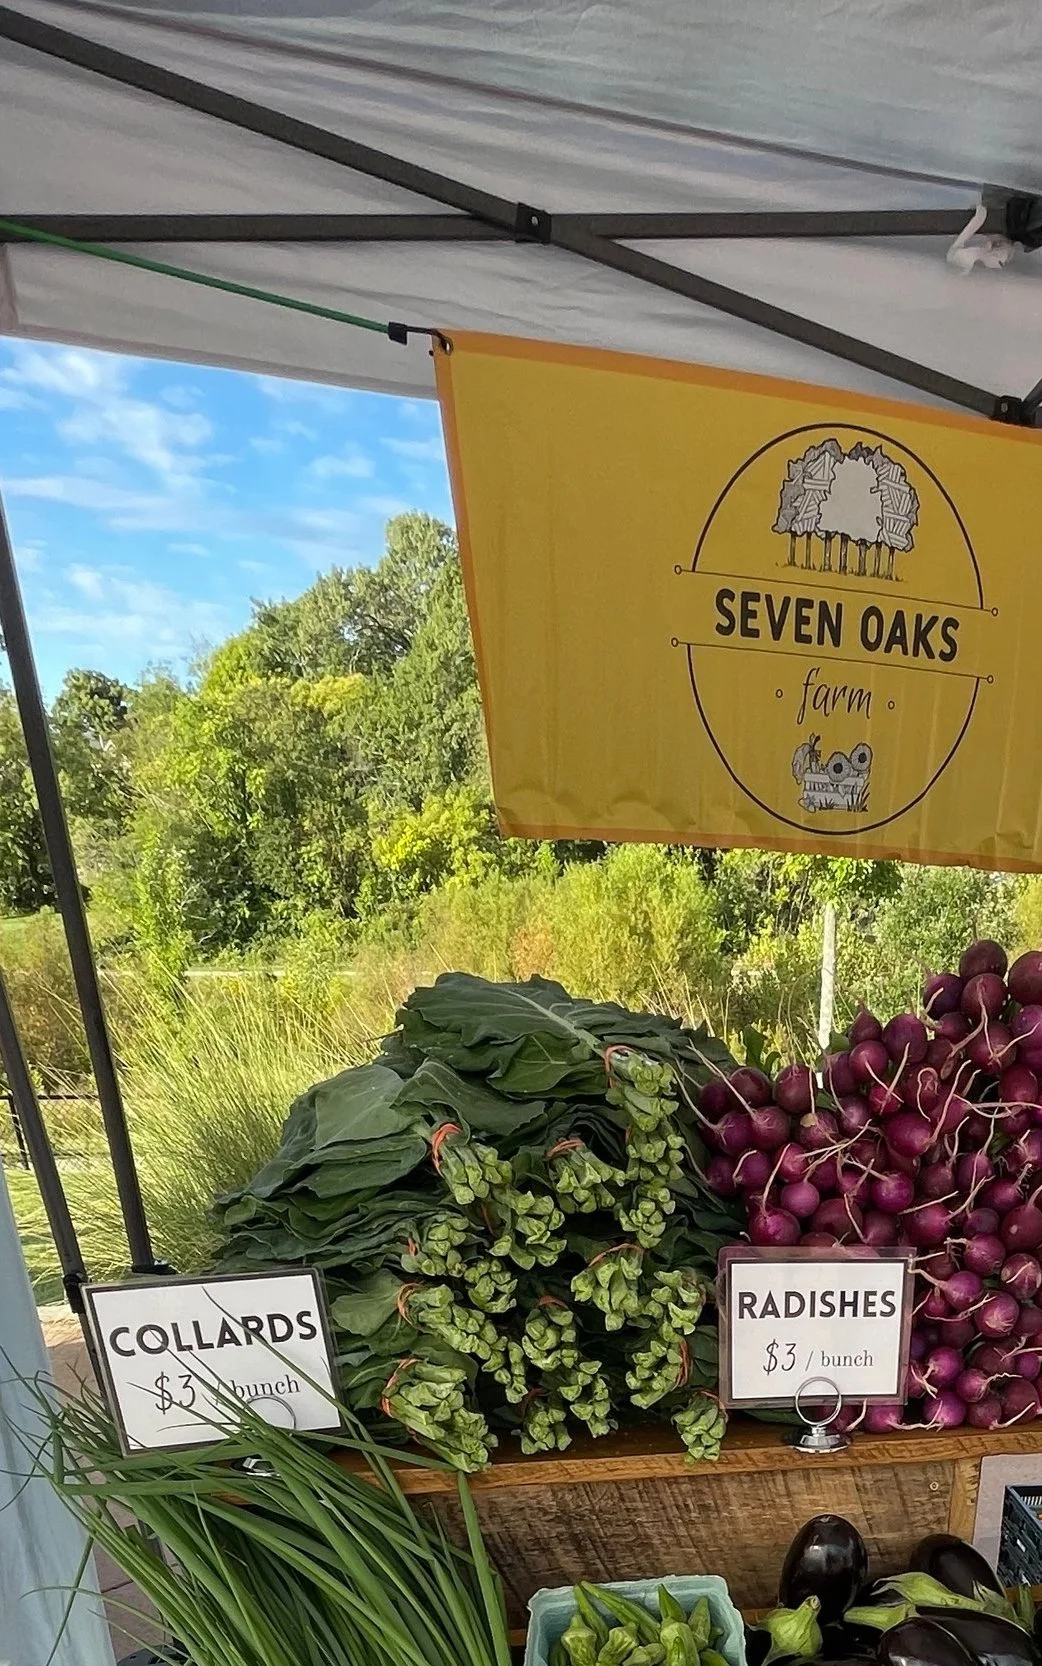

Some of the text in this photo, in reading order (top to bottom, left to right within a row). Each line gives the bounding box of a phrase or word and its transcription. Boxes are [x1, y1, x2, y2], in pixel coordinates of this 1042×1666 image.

[715, 588, 960, 662] SEVEN OAKS
[797, 667, 872, 724] farm
[738, 1290, 896, 1319] RADISHES
[109, 1310, 317, 1357] COLLARDS
[763, 1339, 796, 1376] $3
[821, 1350, 873, 1367] bunch
[154, 1371, 196, 1415] $3
[230, 1374, 300, 1398] bunch
